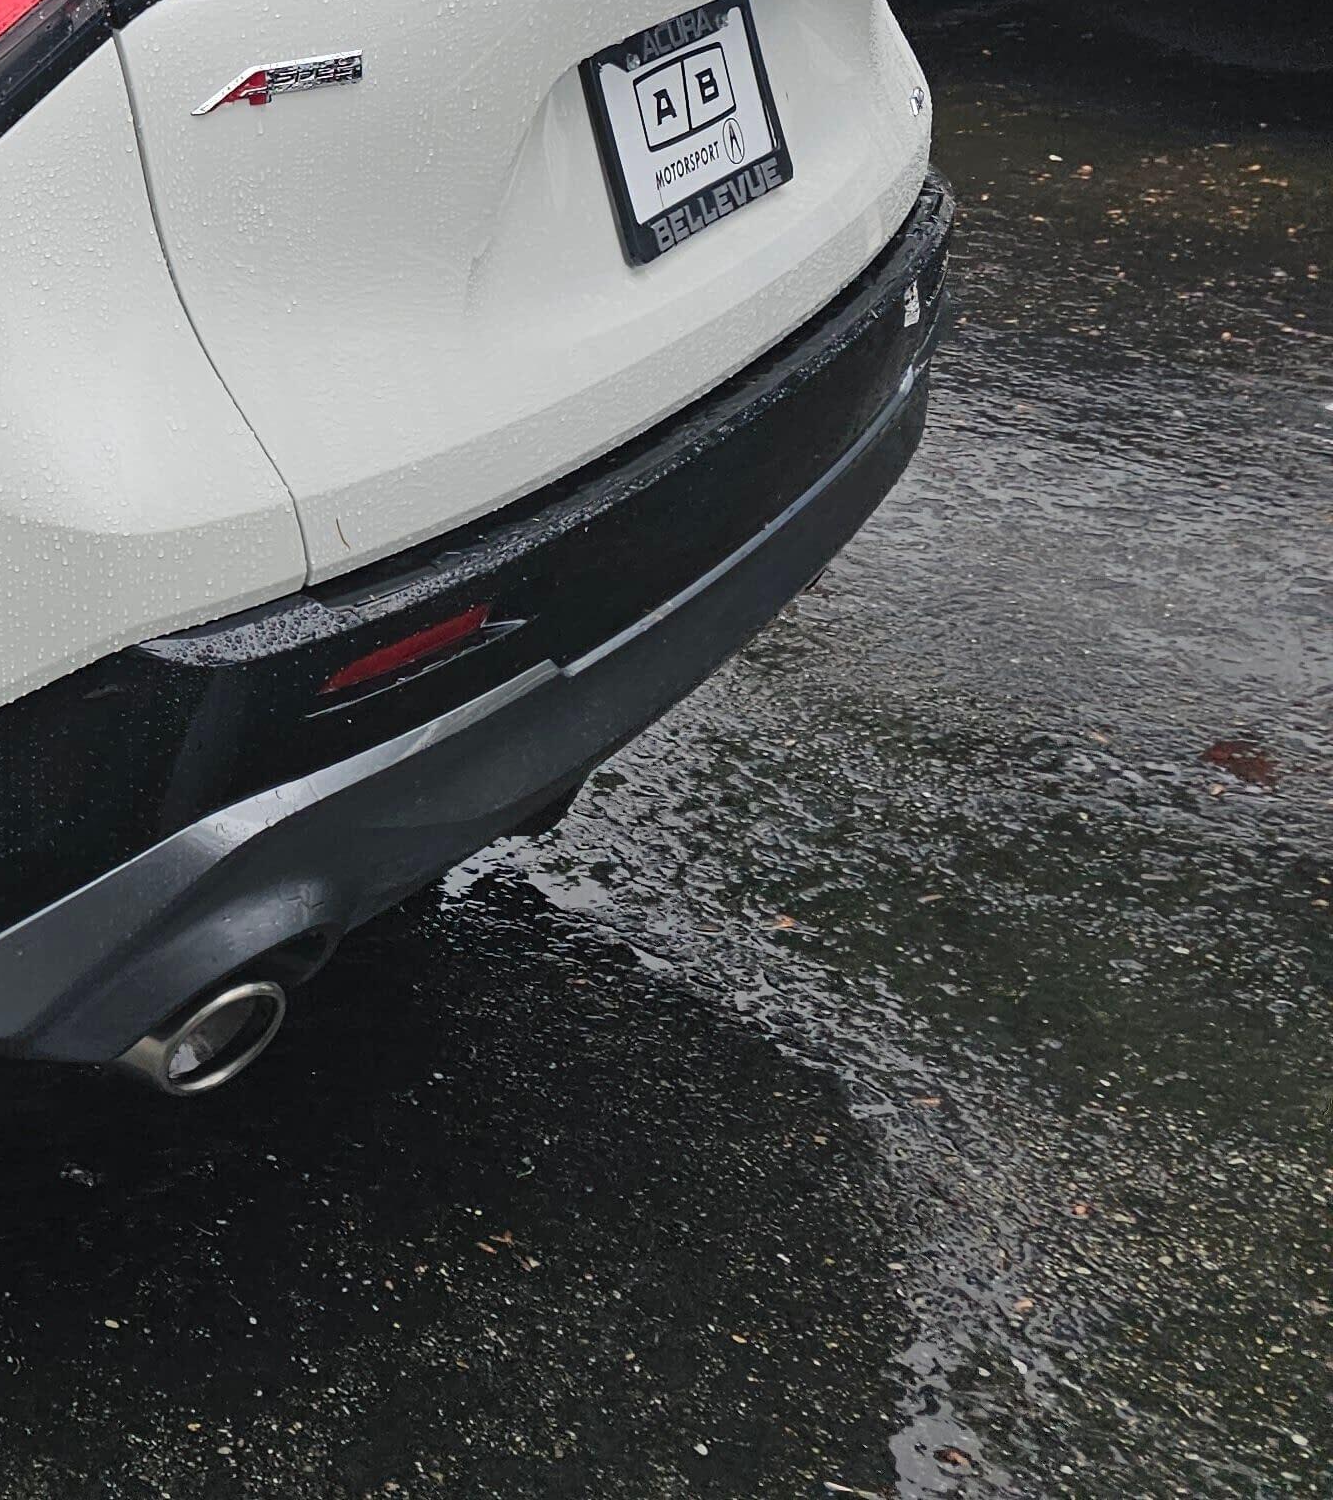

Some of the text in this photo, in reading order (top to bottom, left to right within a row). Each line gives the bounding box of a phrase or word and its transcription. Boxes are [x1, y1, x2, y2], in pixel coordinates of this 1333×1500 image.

[643, 8, 713, 62] ACURA
[653, 67, 720, 126] A B
[655, 140, 721, 191] MOTORSPORT
[650, 156, 783, 252] BELLEVUE
